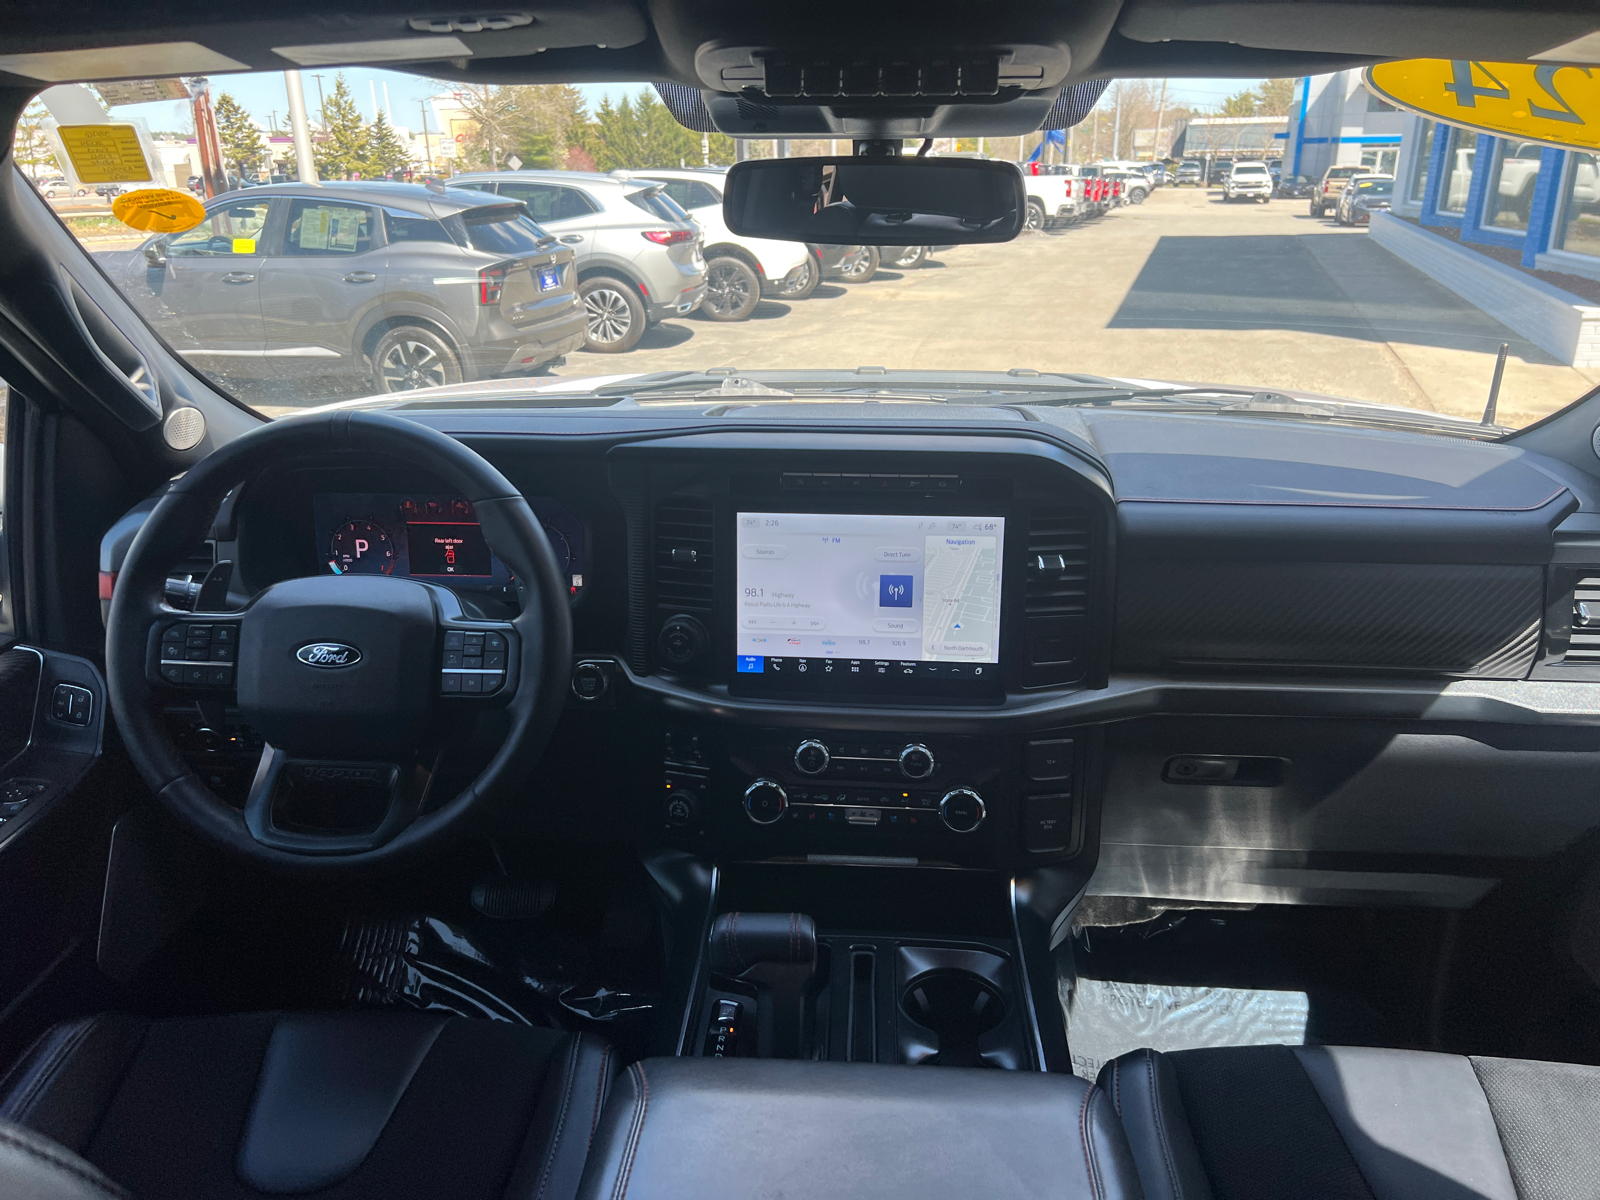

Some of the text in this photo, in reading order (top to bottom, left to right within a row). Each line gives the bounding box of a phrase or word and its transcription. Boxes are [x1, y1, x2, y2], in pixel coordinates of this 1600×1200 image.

[355, 539, 369, 558] P
[745, 588, 764, 597] 98.1
[308, 646, 348, 664] Ford
